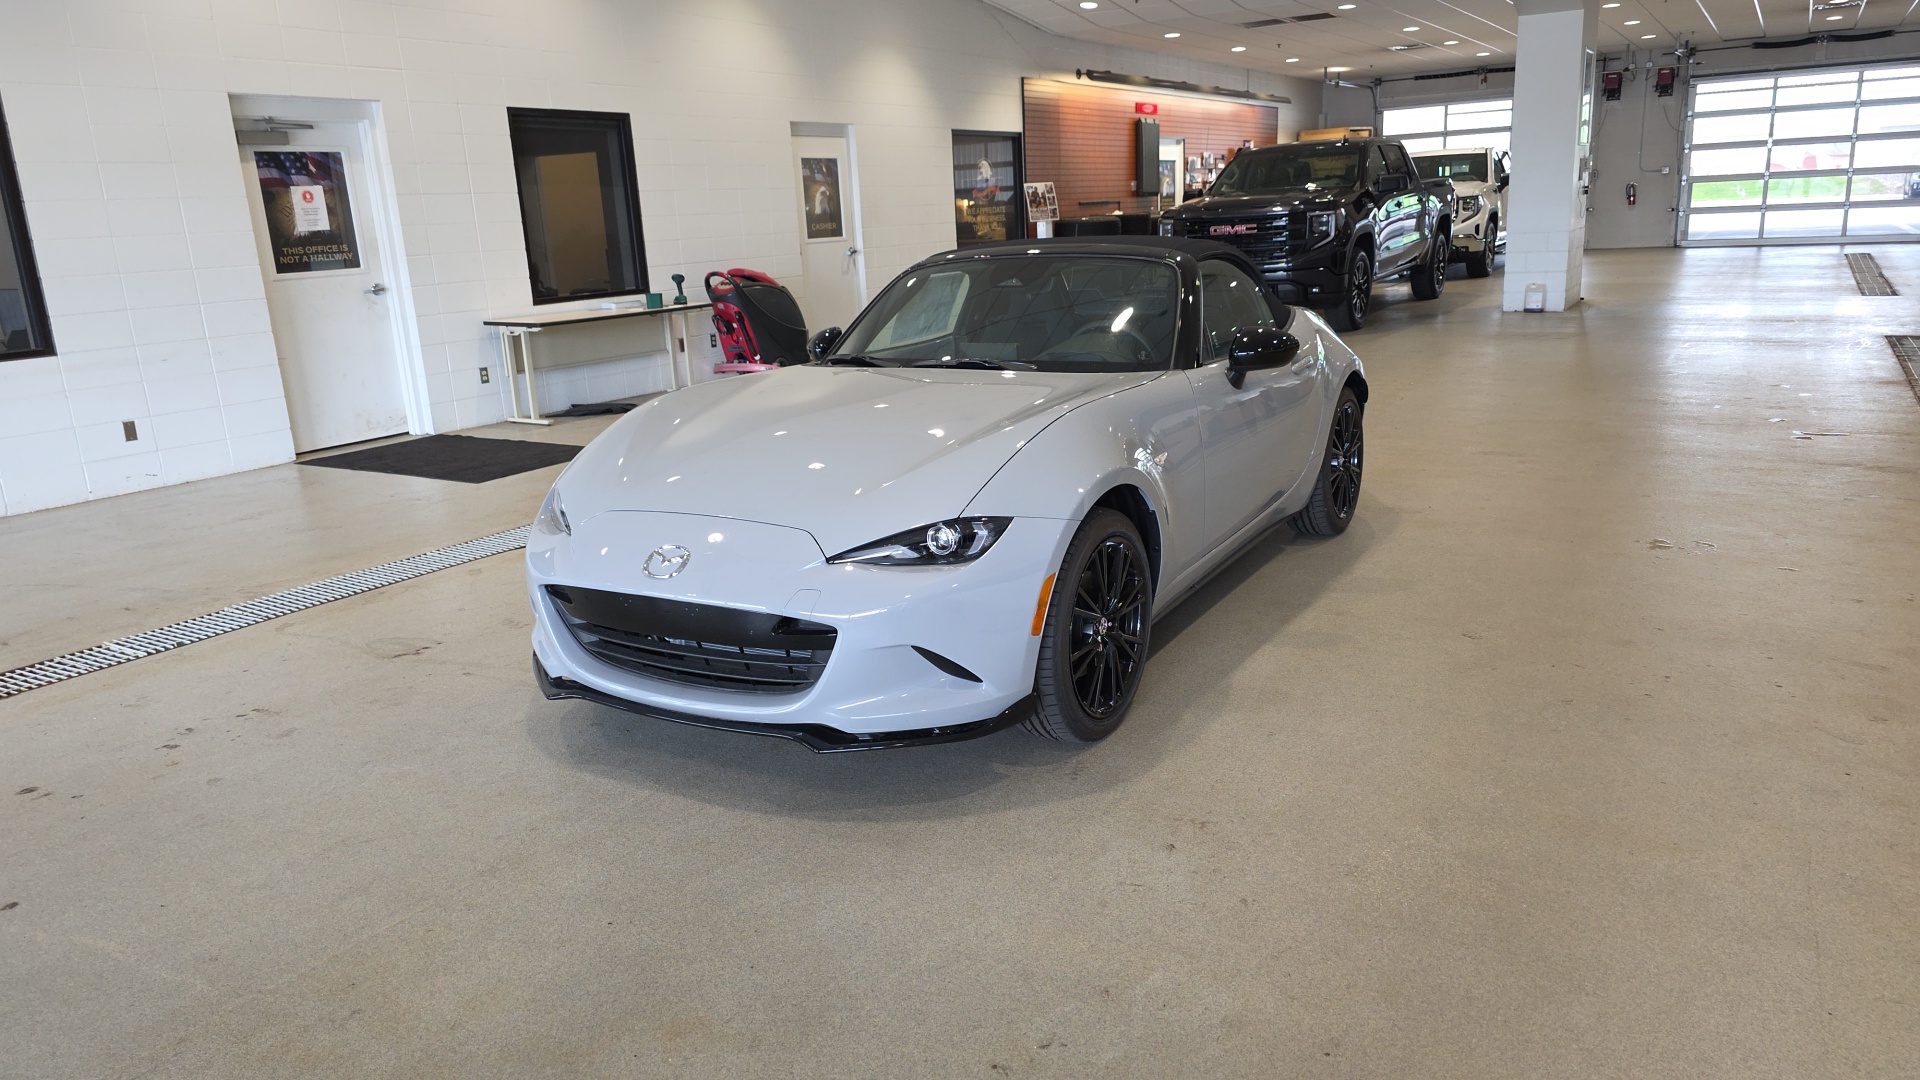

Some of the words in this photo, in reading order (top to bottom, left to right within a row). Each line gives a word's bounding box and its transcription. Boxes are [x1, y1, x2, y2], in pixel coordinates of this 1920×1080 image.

[976, 206, 1006, 214] APPRECIATE
[811, 222, 837, 230] CASHIER
[1210, 224, 1257, 235] GMC
[281, 246, 304, 255] THIS
[305, 244, 339, 254] OFFICE
[340, 244, 349, 252] IS
[279, 255, 300, 264] NOT
[302, 255, 309, 263] A
[310, 252, 353, 262] HALLWAY
